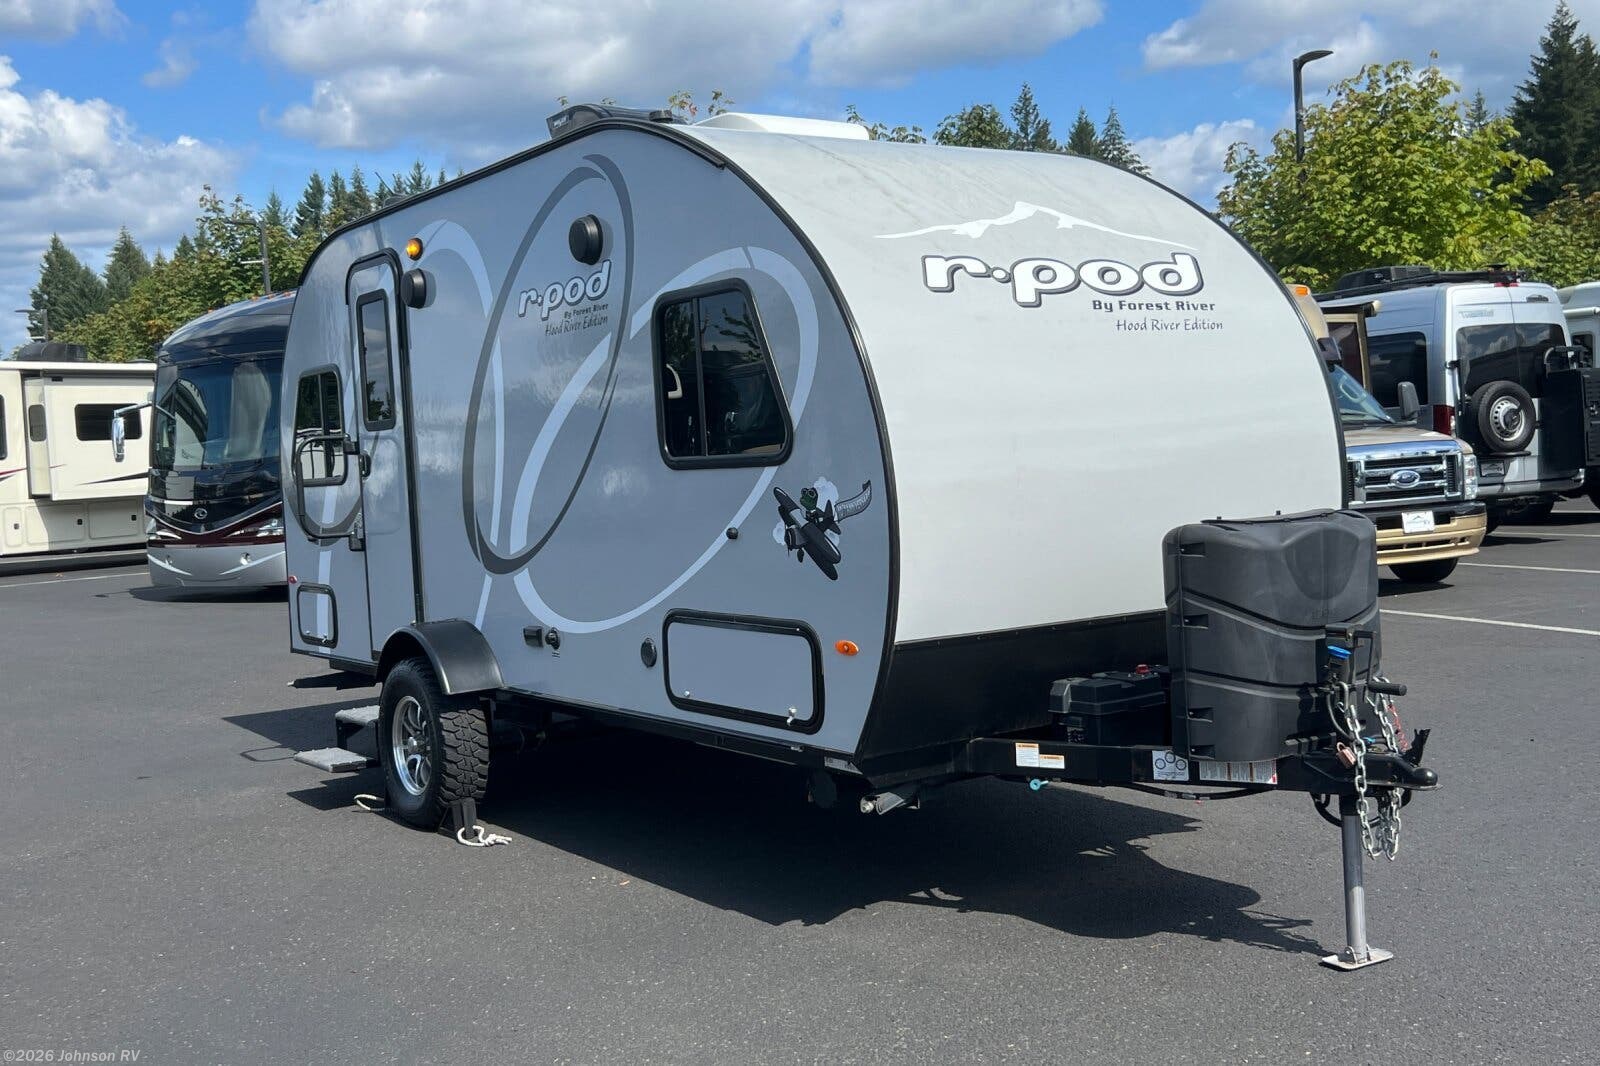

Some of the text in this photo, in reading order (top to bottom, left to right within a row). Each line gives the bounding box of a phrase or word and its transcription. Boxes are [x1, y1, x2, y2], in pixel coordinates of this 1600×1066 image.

[573, 306, 592, 316] Forest
[593, 303, 609, 313] River
[1093, 300, 1216, 312] By Forest River
[545, 315, 608, 336] Hood River Edition
[1116, 317, 1223, 331] Hood River Edition
